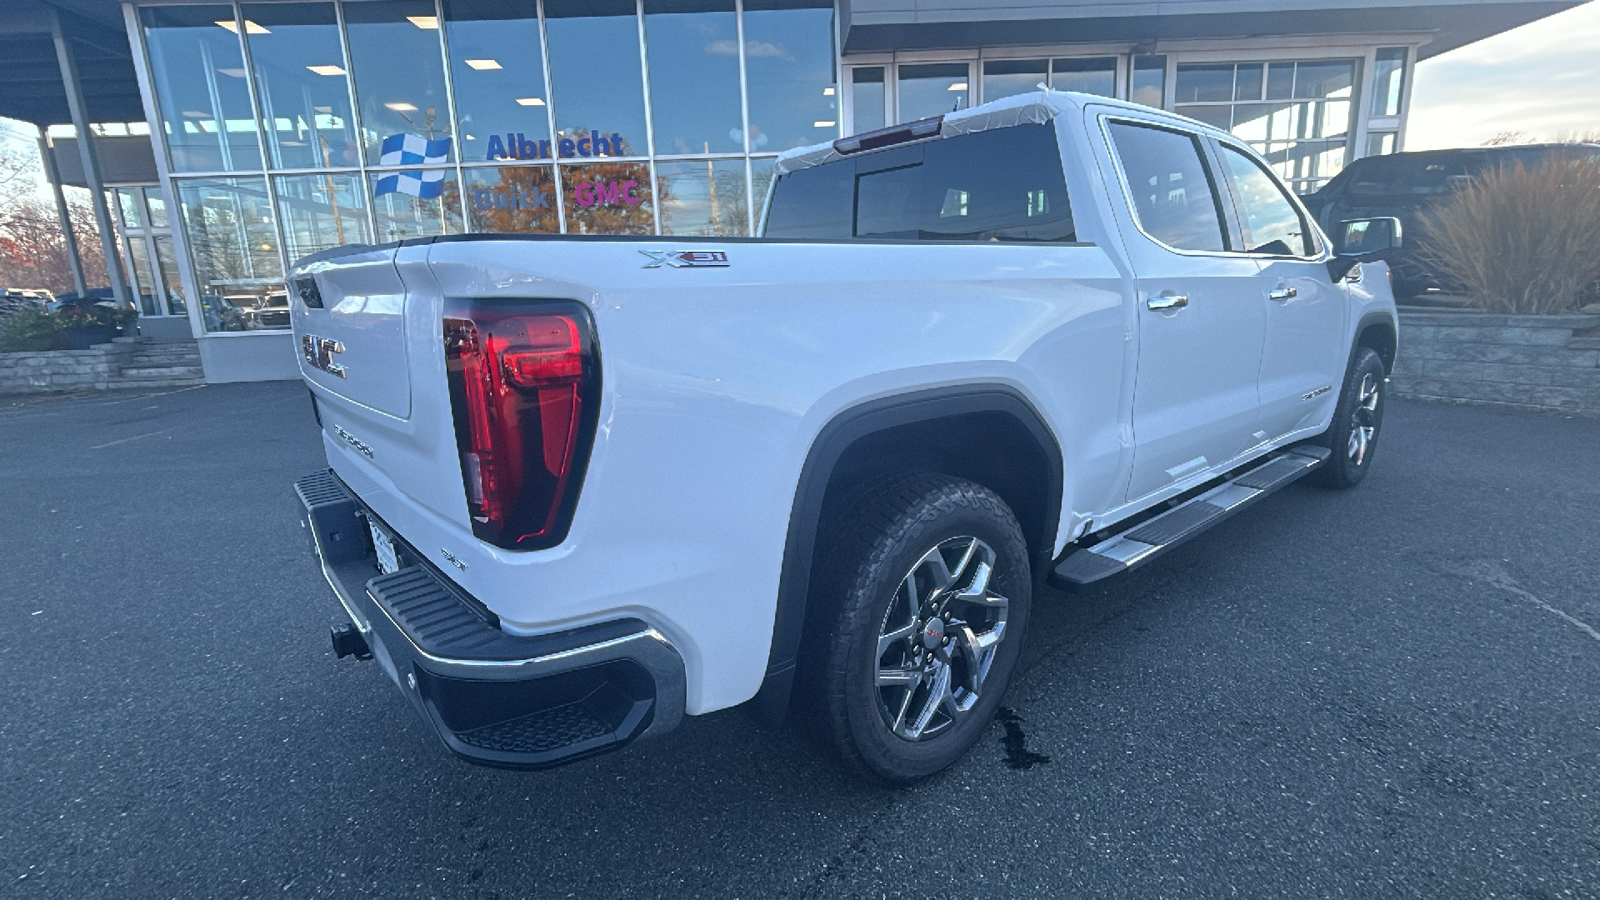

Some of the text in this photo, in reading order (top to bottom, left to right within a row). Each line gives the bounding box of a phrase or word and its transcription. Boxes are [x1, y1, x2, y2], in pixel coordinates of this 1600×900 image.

[487, 130, 624, 160] Albrecht
[475, 180, 640, 210] Buick GMC
